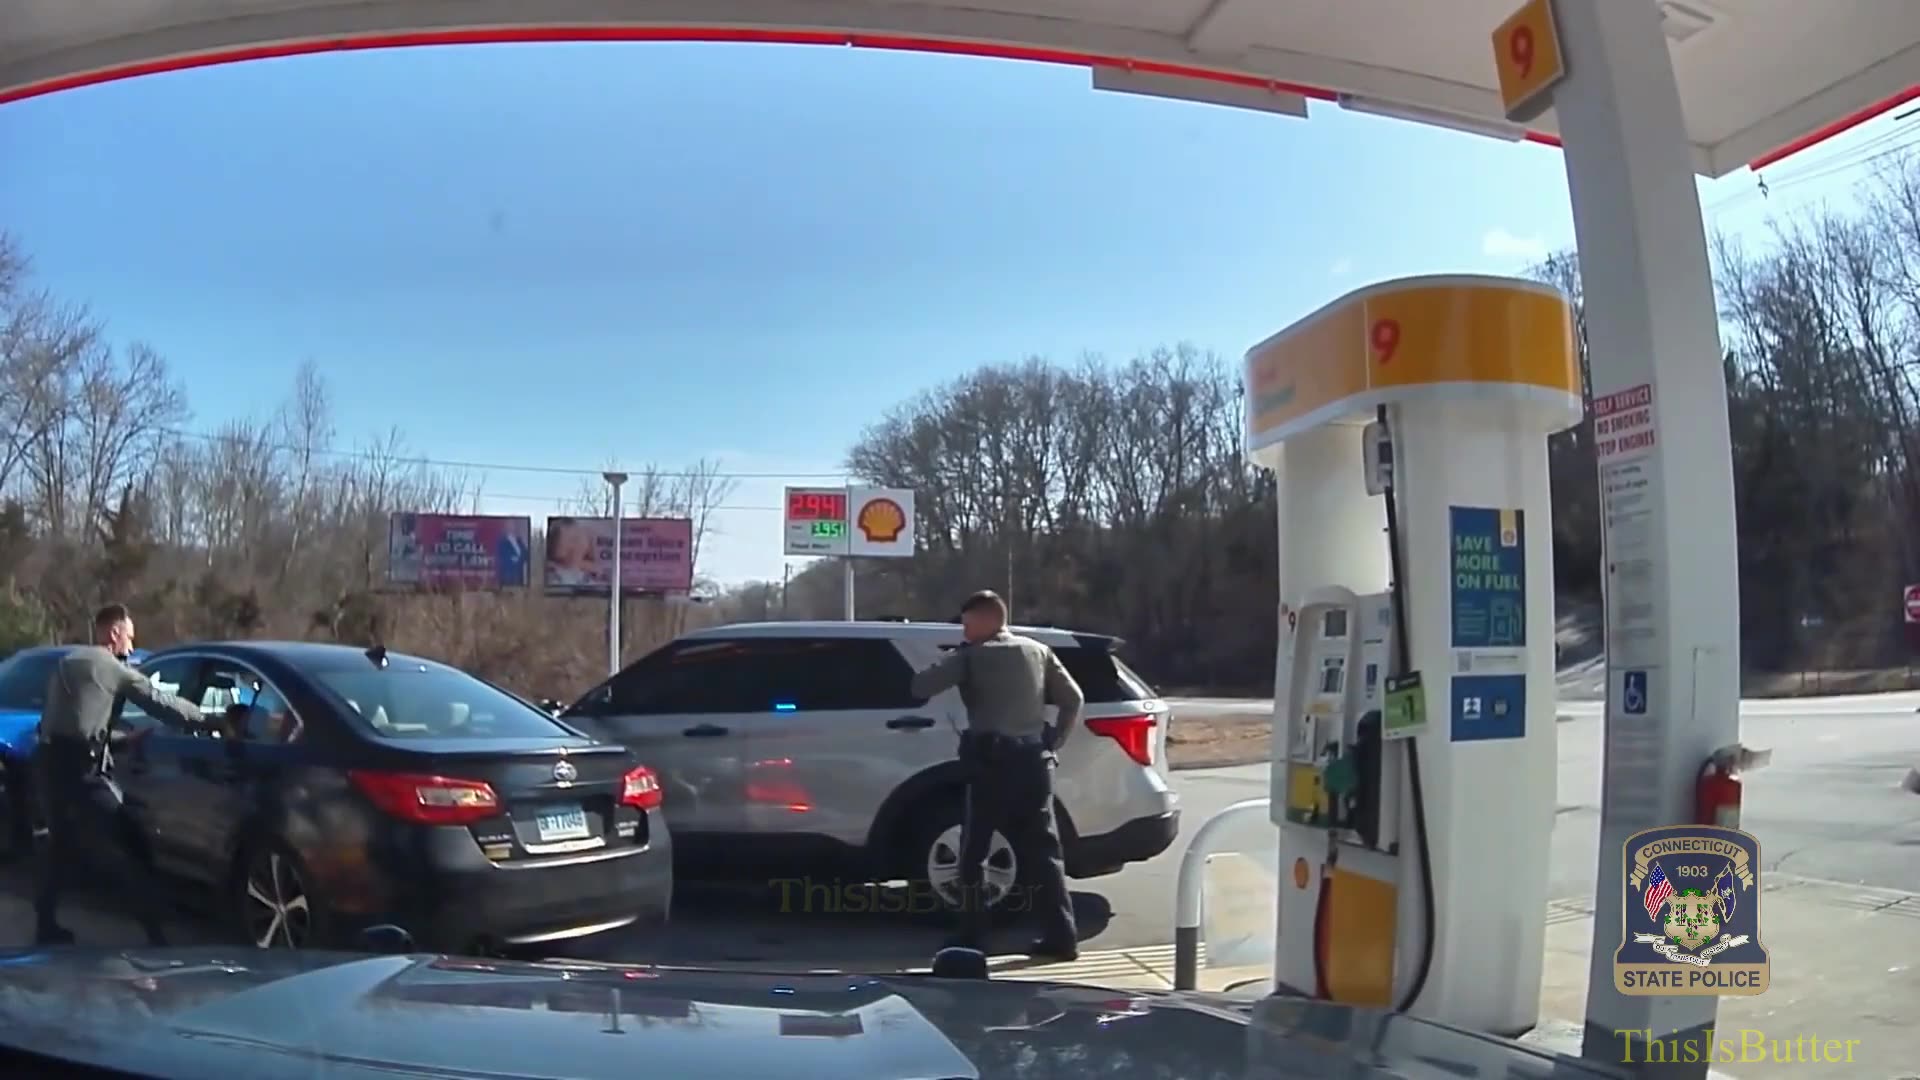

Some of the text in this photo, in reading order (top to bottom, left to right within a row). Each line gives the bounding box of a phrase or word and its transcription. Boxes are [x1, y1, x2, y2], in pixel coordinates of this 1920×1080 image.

[1511, 25, 1534, 79] 9
[1371, 318, 1400, 364] 9
[1597, 407, 1650, 435] NO SMOKING
[1618, 429, 1655, 453] ENGINES
[1455, 534, 1492, 553] SAVE
[599, 550, 681, 565] Cnception
[1455, 553, 1501, 572] MORE
[1456, 573, 1521, 591] ON FUEL
[1288, 611, 1297, 633] 9
